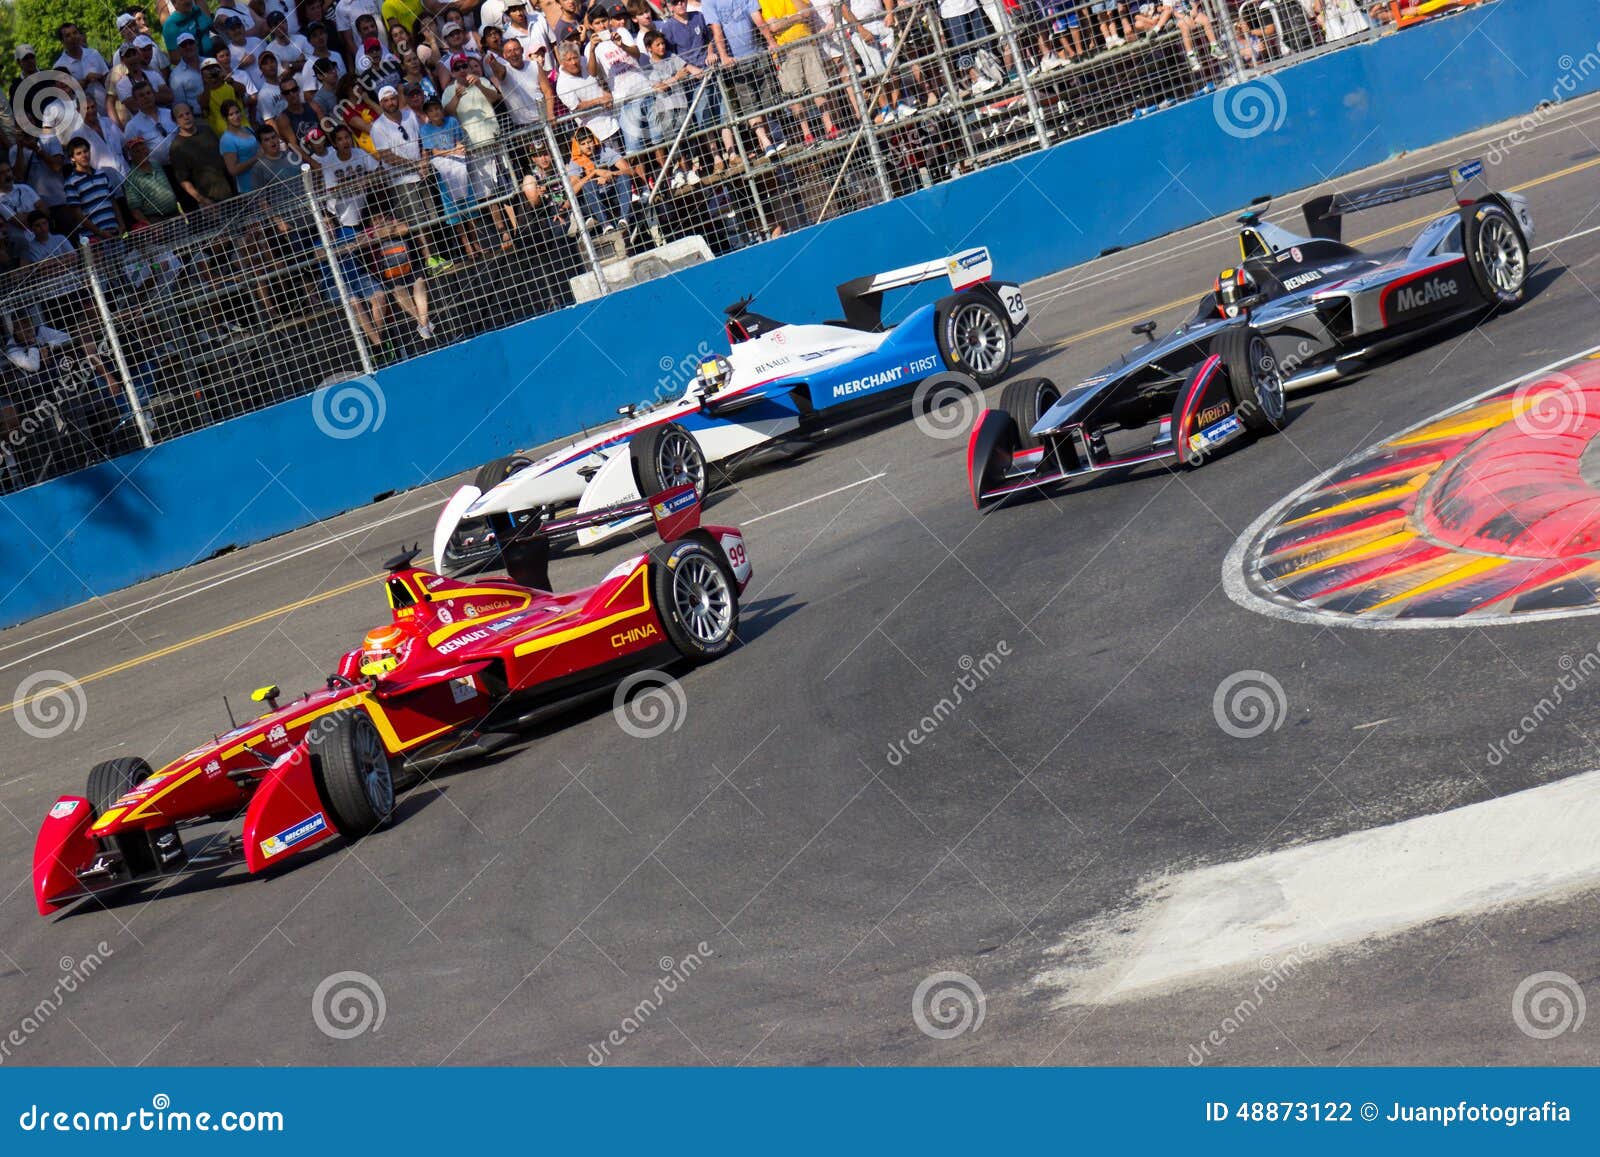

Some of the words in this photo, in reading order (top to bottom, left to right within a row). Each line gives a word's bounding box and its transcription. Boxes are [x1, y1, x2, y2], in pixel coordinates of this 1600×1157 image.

[1283, 271, 1322, 291] RENAULT
[1006, 293, 1024, 314] 28
[1397, 278, 1458, 313] McAfee
[755, 355, 791, 375] RENAULT
[833, 366, 902, 398] MERCHANT
[910, 355, 937, 374] FIRST
[729, 544, 747, 568] 99
[437, 629, 490, 655] RENAULT
[611, 623, 658, 648] CHINA
[285, 818, 323, 842] MICHELIN
